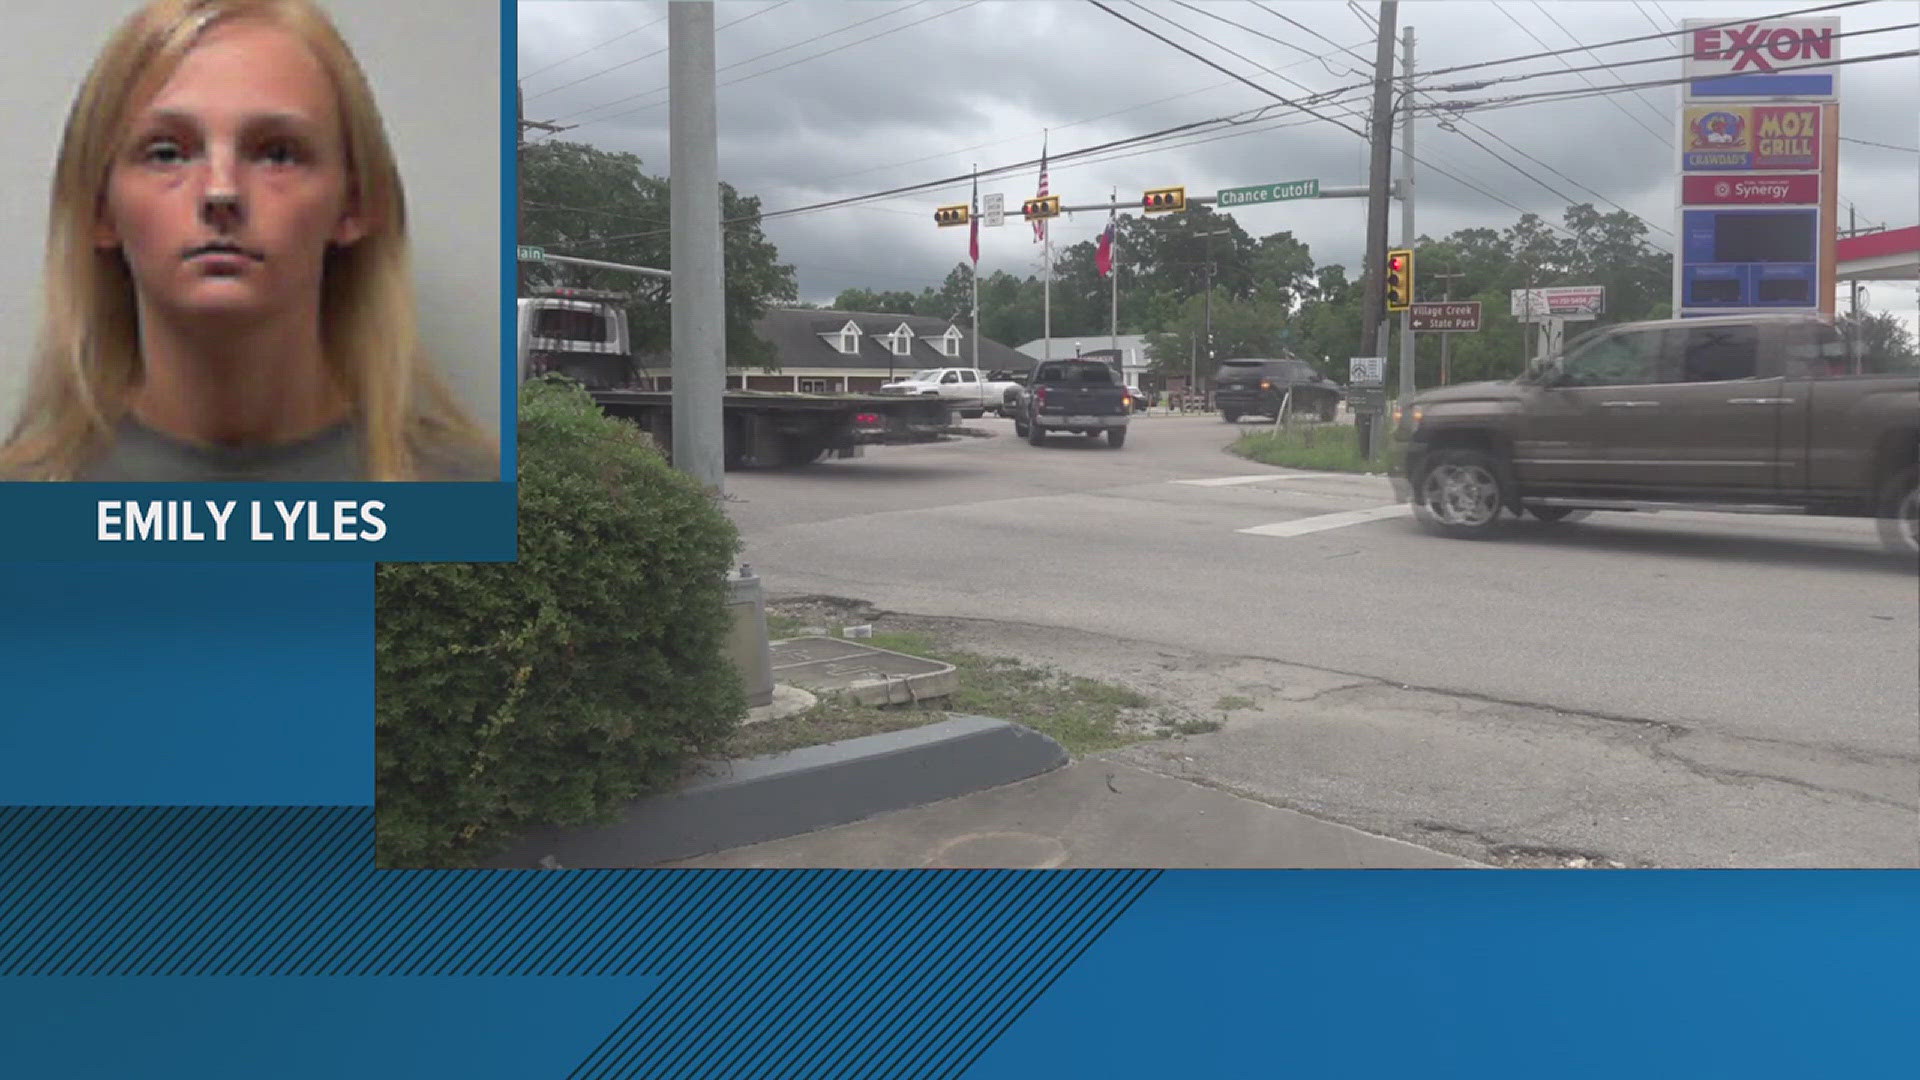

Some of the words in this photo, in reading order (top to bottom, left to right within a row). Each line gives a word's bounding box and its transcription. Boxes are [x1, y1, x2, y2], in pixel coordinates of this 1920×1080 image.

[1693, 24, 1832, 74] EXXON
[1759, 111, 1815, 138] MOZ
[1758, 138, 1812, 156] GRILL
[1220, 188, 1268, 206] Chance
[1272, 181, 1315, 202] Cutoff
[1735, 183, 1790, 198] Synergy
[1412, 305, 1443, 317] Village
[1446, 304, 1472, 315] Creek
[1429, 318, 1453, 329] State
[1455, 317, 1476, 328] Park
